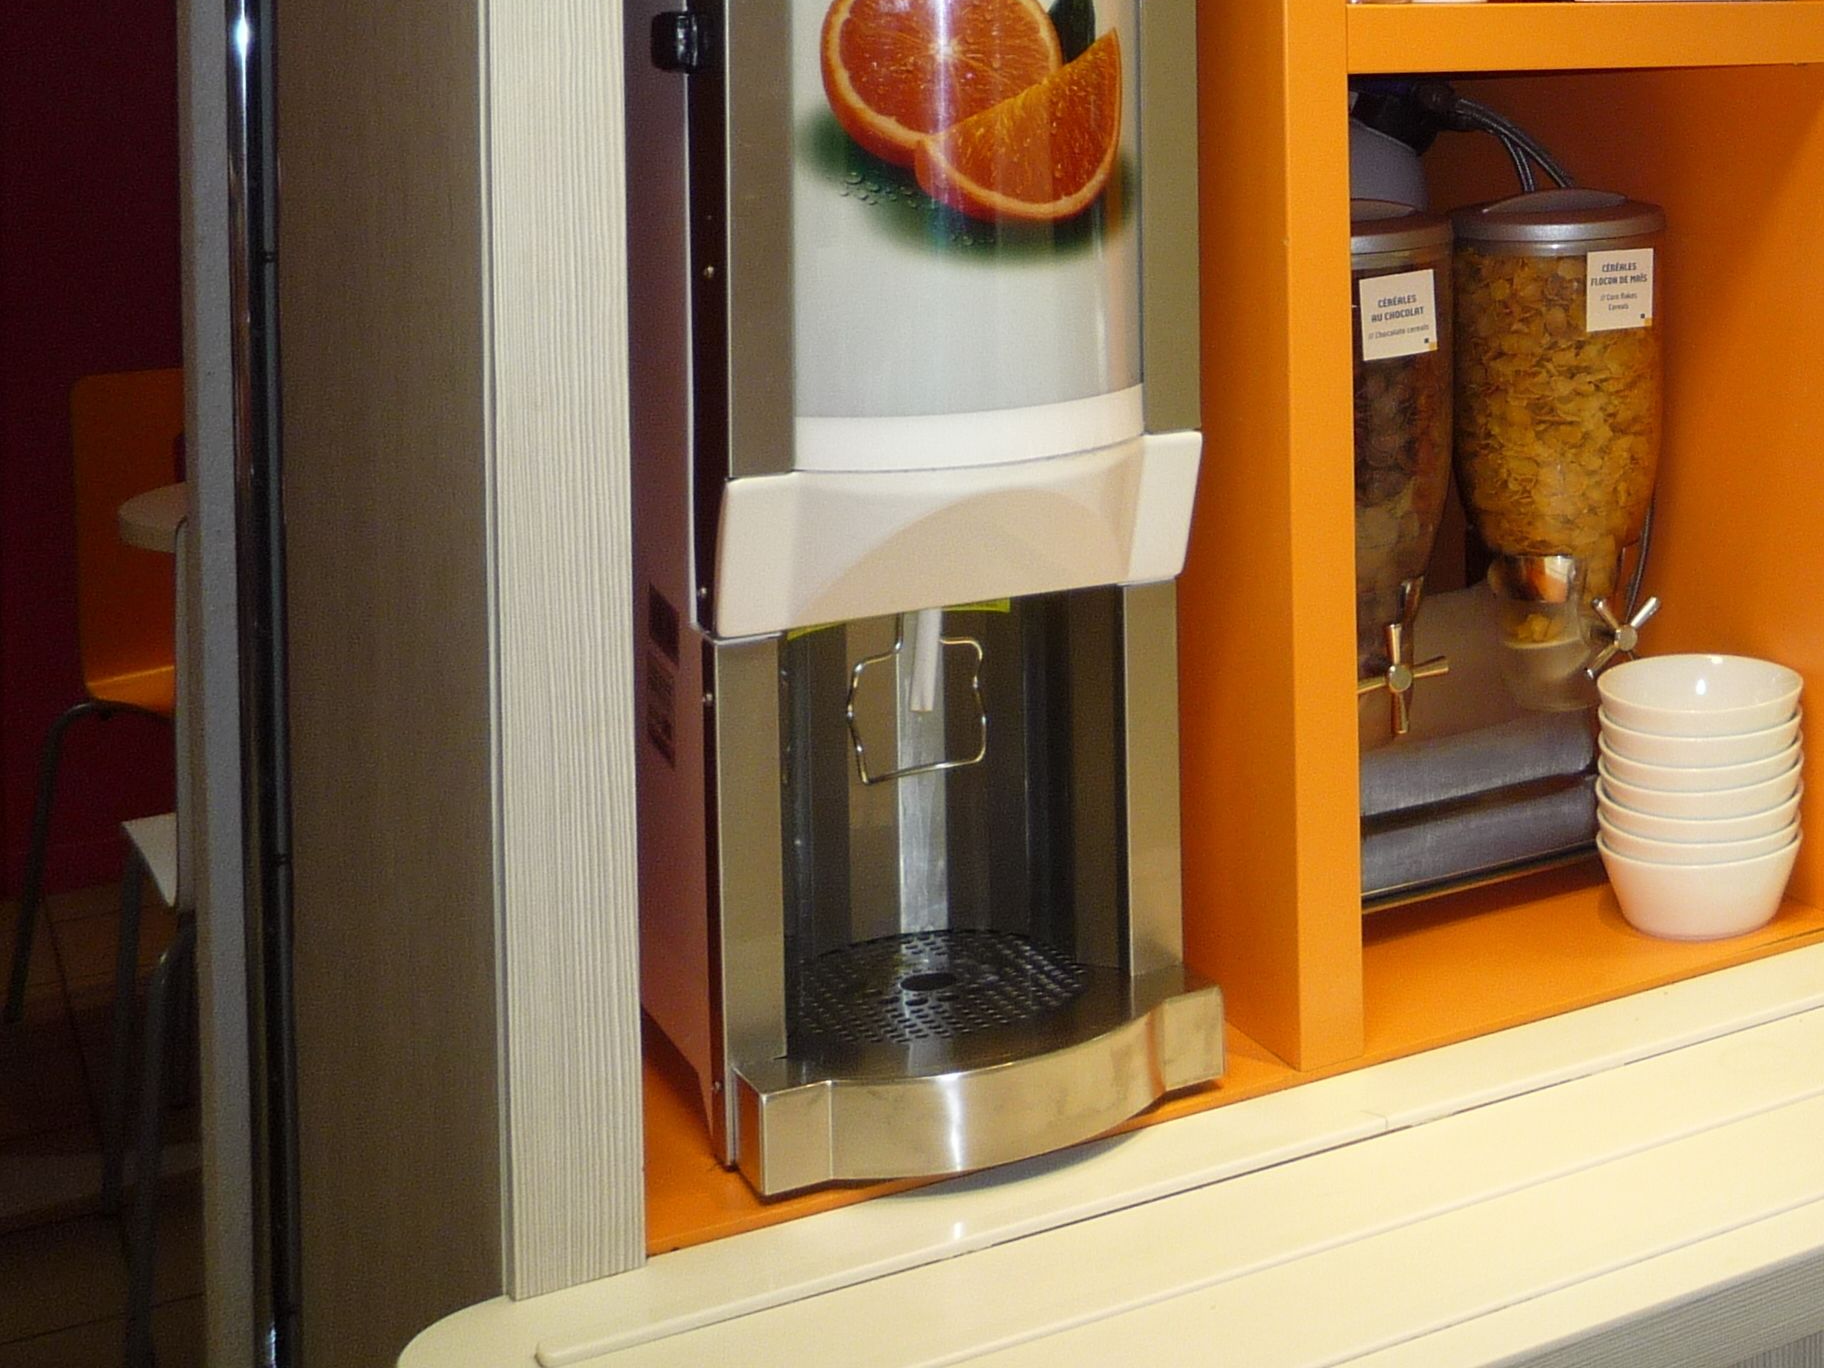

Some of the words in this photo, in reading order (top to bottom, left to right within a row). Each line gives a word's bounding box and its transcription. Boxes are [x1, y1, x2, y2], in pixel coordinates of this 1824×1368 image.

[1601, 262, 1637, 273] CÉRÉALES
[1590, 276, 1618, 287] FLOCON
[1619, 275, 1628, 284] DE
[1377, 294, 1417, 308] CÉRÉALES
[1371, 313, 1383, 323] AU
[1384, 306, 1425, 321] CHOCOLAT
[1375, 327, 1406, 339] Chocolate
